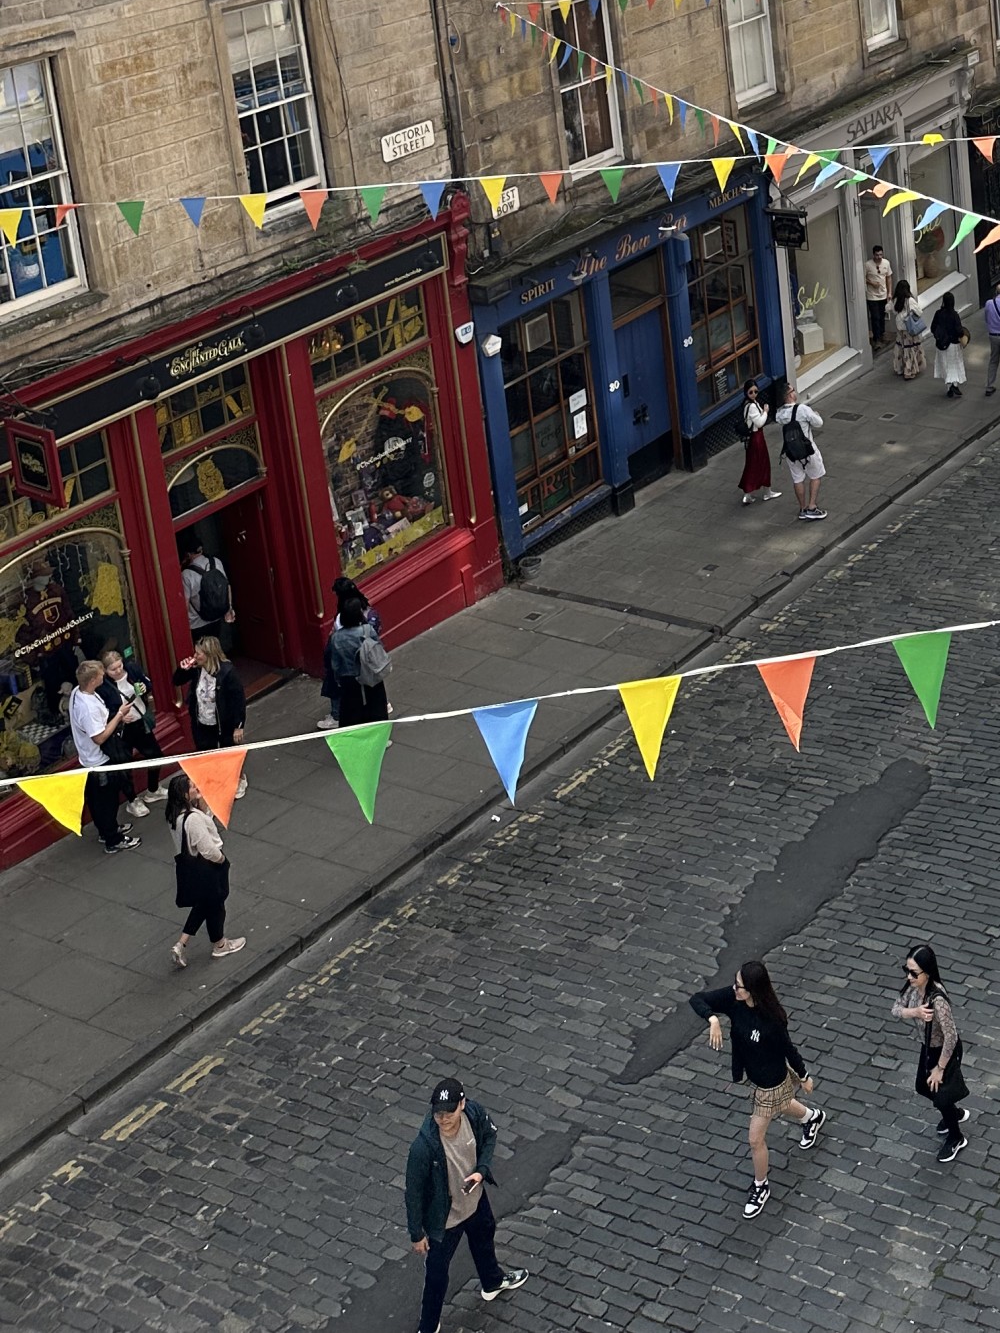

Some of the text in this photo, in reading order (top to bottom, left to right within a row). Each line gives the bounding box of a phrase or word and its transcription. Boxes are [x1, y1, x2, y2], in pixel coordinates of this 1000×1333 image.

[846, 102, 902, 143] SAHARA
[384, 123, 431, 148] VICTORIA
[392, 136, 426, 157] STREET
[497, 199, 516, 217] BOW
[501, 188, 516, 203] EST
[615, 233, 651, 261] Bow
[520, 278, 556, 305] SPIRIT
[795, 281, 829, 320] Sale
[683, 336, 693, 348] 80
[609, 380, 620, 393] 80
[14, 611, 94, 658] @TheEnchantedGalaxy
